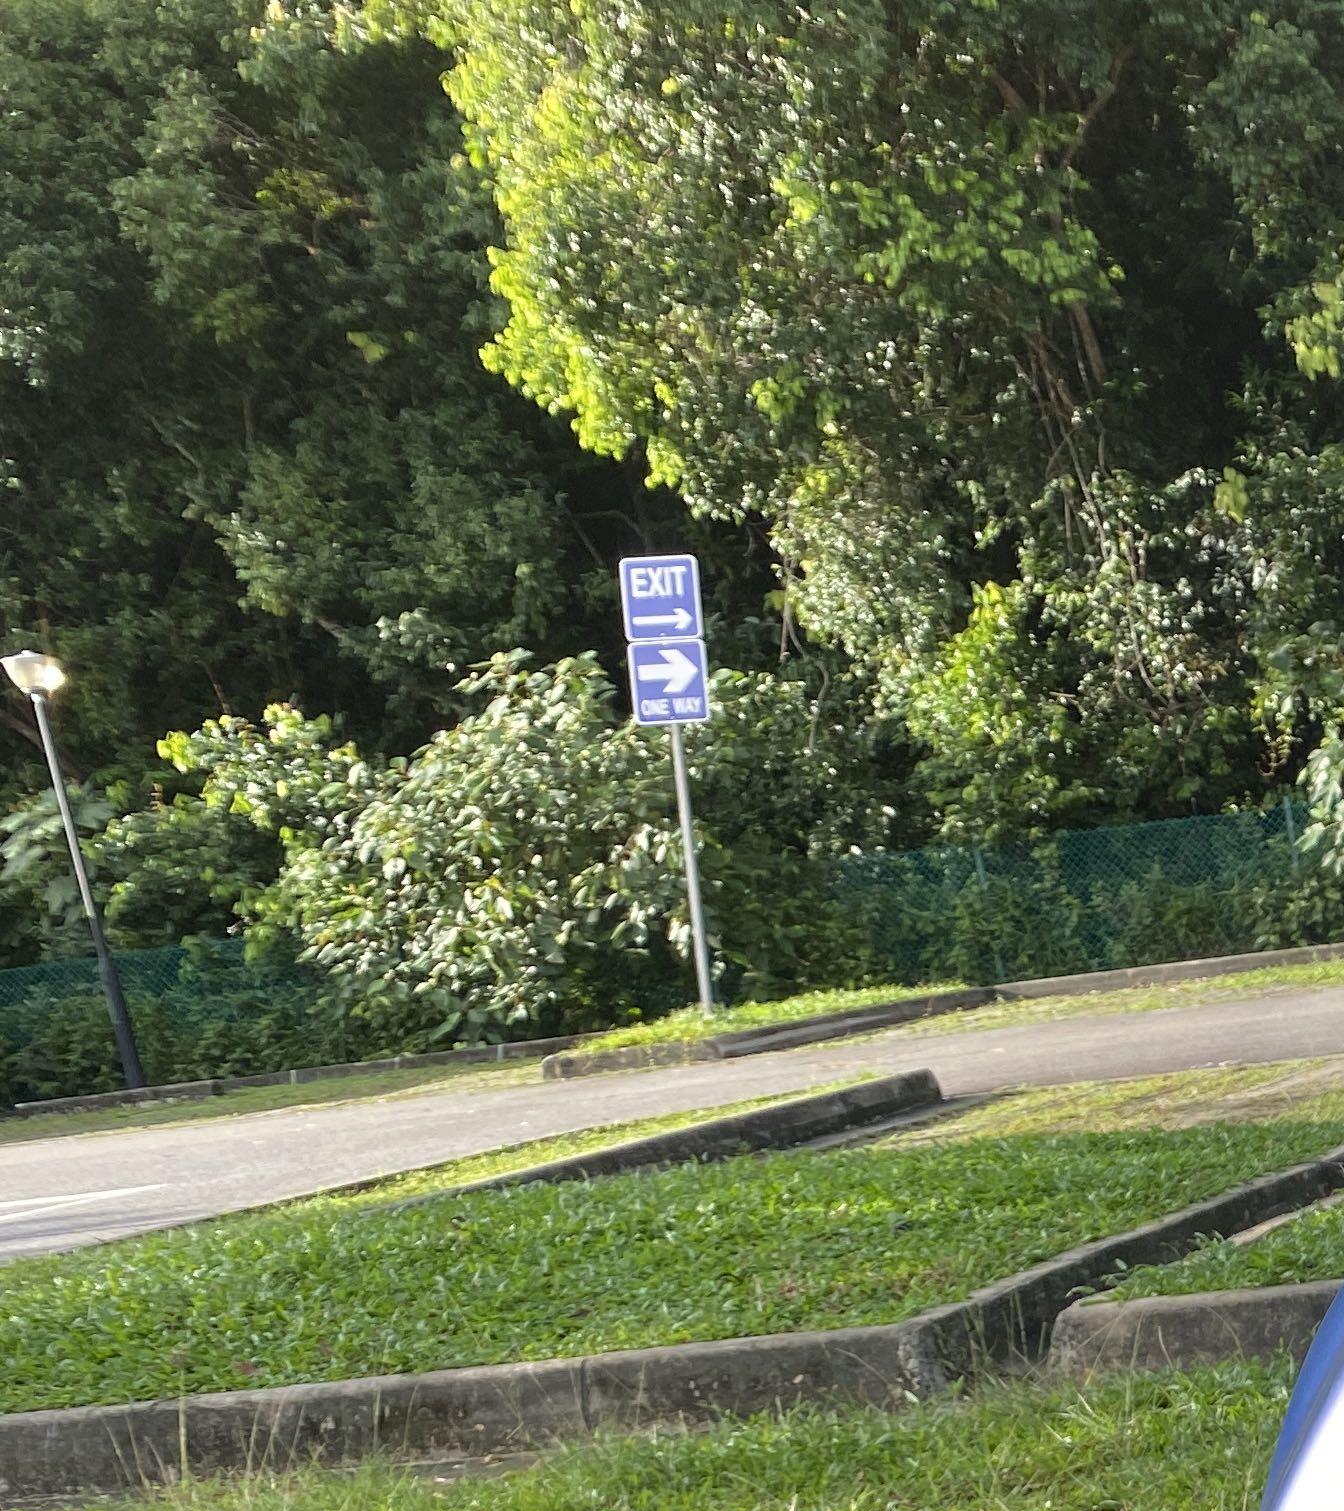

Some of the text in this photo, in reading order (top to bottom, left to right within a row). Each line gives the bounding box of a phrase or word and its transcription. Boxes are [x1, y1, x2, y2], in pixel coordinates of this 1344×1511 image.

[630, 565, 688, 598] EXIT
[641, 697, 702, 715] ONE WAY
